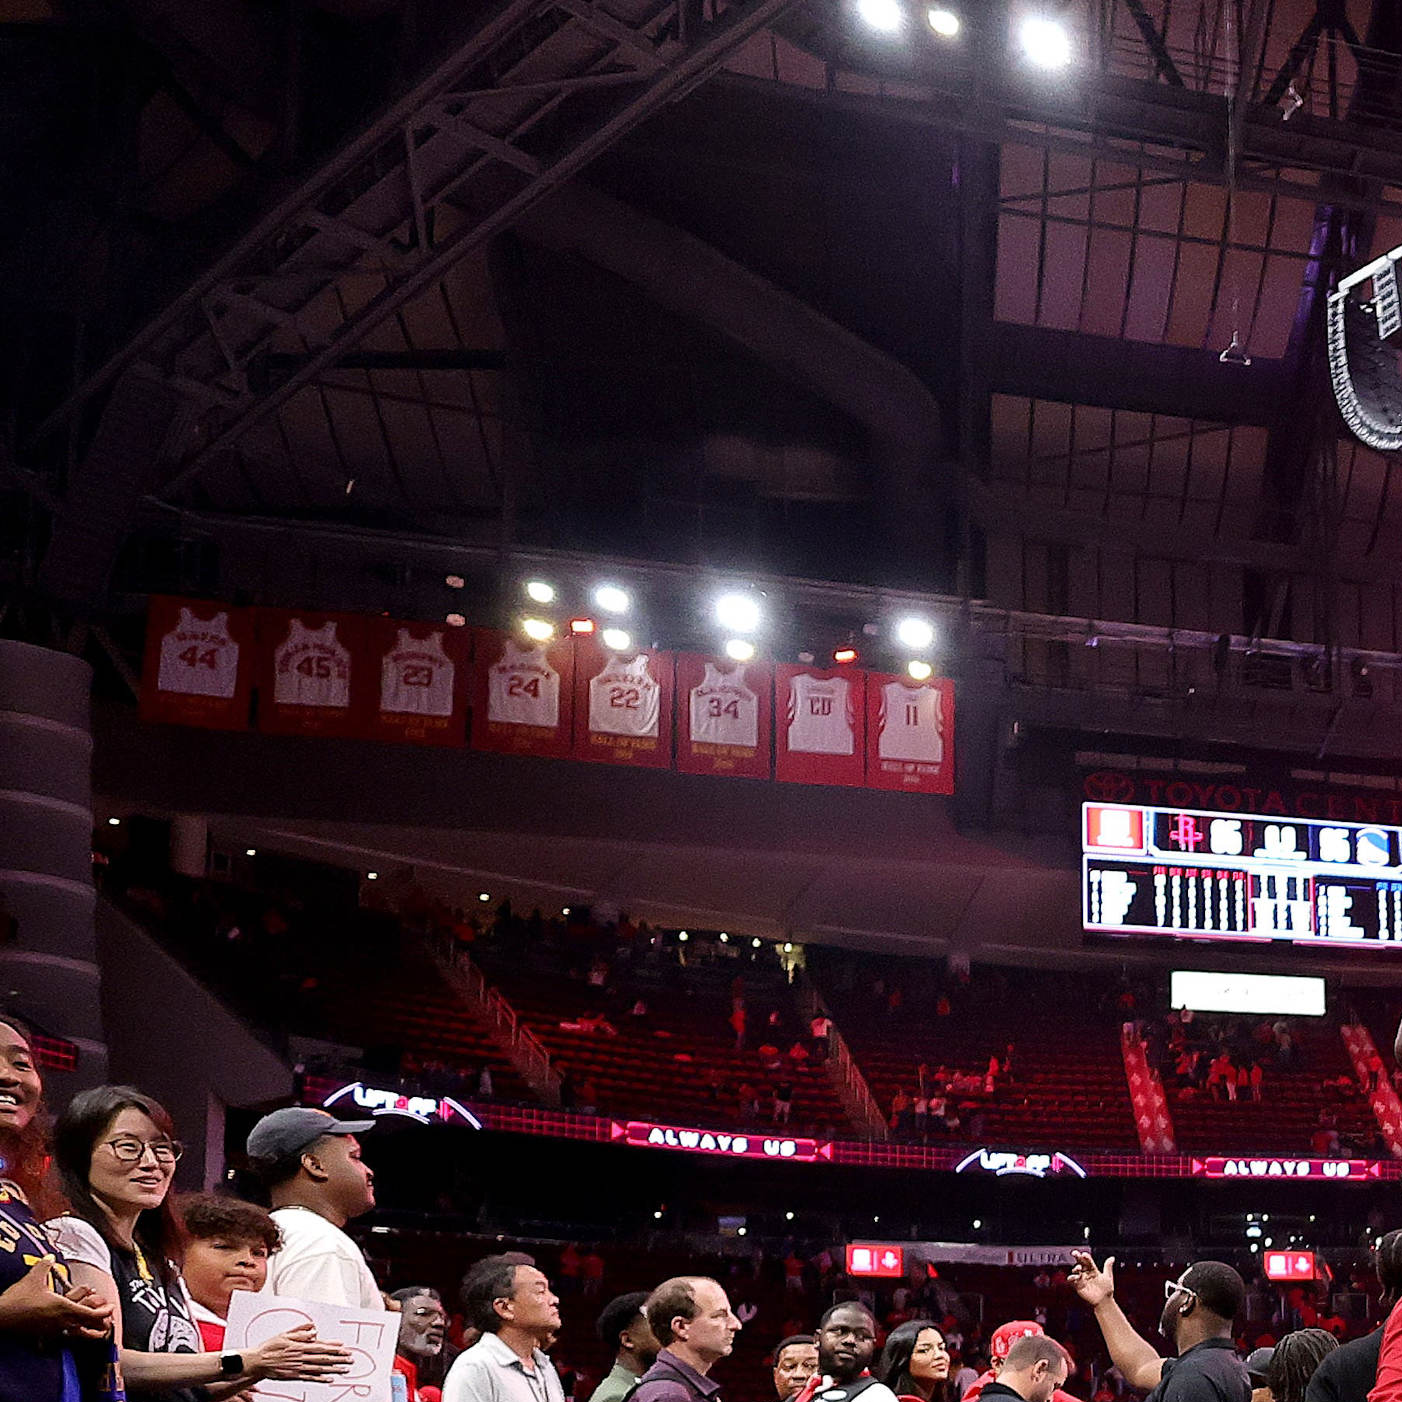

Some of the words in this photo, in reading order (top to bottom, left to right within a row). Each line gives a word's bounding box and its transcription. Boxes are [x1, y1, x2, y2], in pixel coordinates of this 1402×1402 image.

[297, 656, 332, 679] 45
[508, 674, 540, 698] 24
[610, 687, 641, 710] 22
[709, 697, 741, 720] 34
[648, 1127, 748, 1154] ALWAYS
[763, 1139, 796, 1157] US
[1223, 1160, 1310, 1177] ALWAYS
[1322, 1162, 1350, 1177] US
